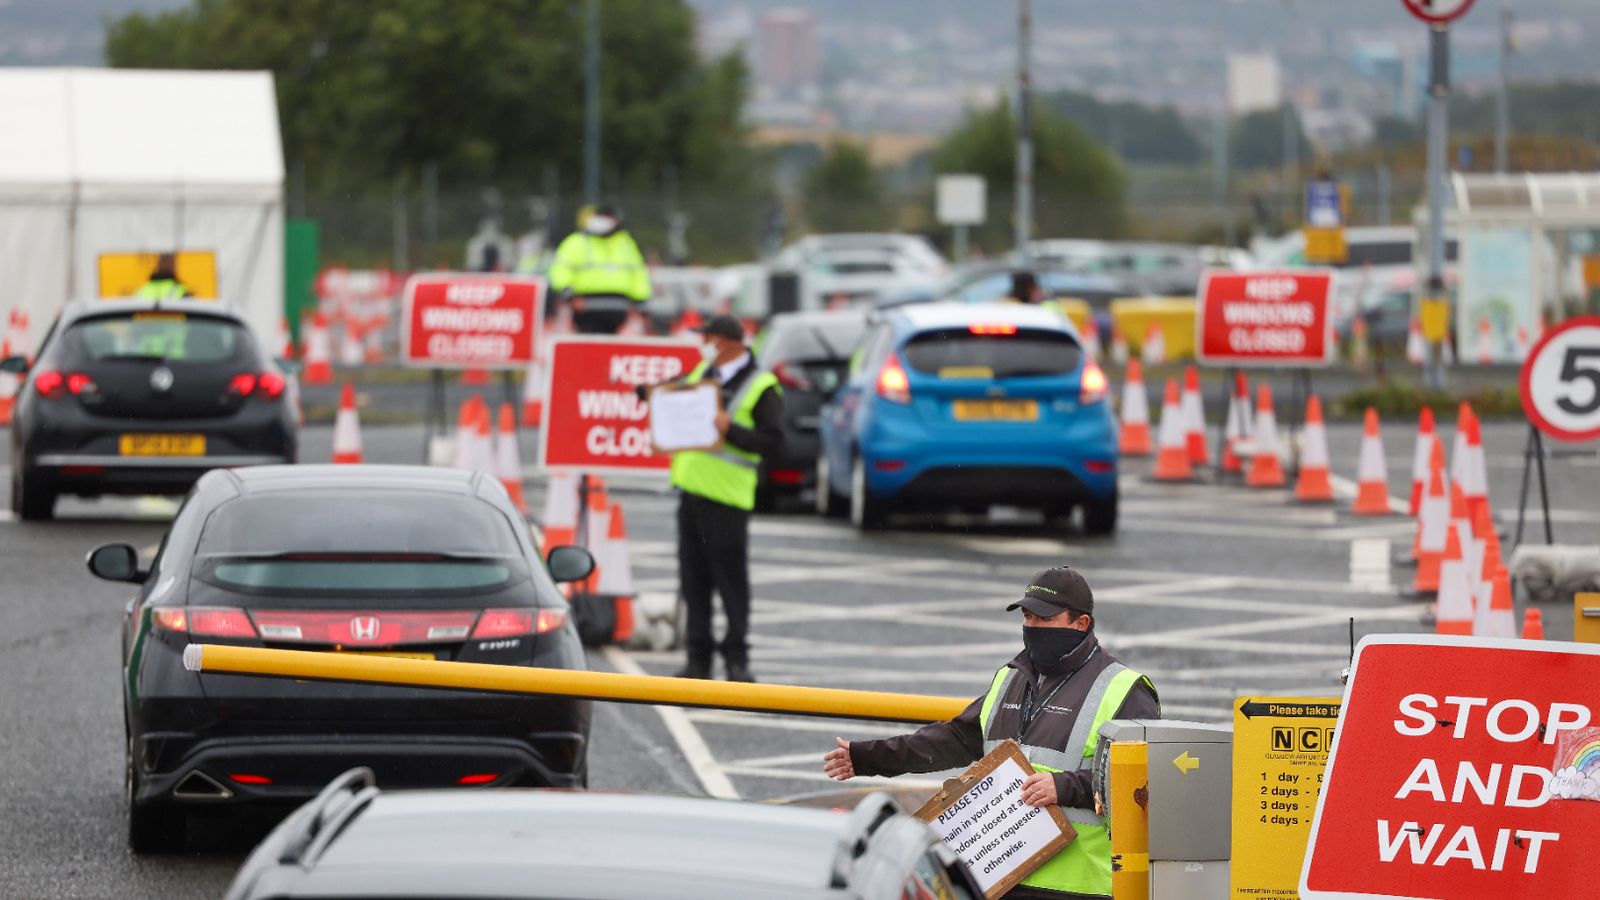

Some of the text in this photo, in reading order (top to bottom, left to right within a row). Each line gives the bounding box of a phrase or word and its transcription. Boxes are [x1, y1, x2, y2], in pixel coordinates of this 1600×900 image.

[447, 283, 505, 304] KEEP
[1246, 278, 1298, 300] KEEP
[422, 307, 524, 333] WINDOWS
[1223, 302, 1315, 327] WINDOWS
[428, 334, 514, 359] CLOSED
[1229, 327, 1306, 353] CLOSED
[611, 355, 682, 384] KEEP
[1556, 346, 1600, 416] 5
[1269, 705, 1303, 716] Please
[1306, 706, 1328, 716] take
[1393, 693, 1592, 745] STOP
[1261, 772, 1267, 781] 1
[1278, 772, 1299, 784] day
[1394, 758, 1554, 808] AND
[938, 776, 994, 825] PLEASE STOP
[962, 818, 972, 831] in
[972, 804, 991, 823] your
[991, 794, 1004, 807] car
[1005, 777, 1024, 796] with
[1260, 786, 1268, 795] 2
[1271, 786, 1299, 798] days
[1260, 800, 1268, 810] 3
[1271, 801, 1299, 812] days
[981, 812, 1008, 835] closed
[1007, 804, 1018, 816] at
[1260, 815, 1267, 824] 4
[1271, 815, 1299, 826] days
[974, 838, 1000, 861] unless
[983, 840, 1027, 875] otherwise.
[1377, 819, 1560, 874] WAIT
